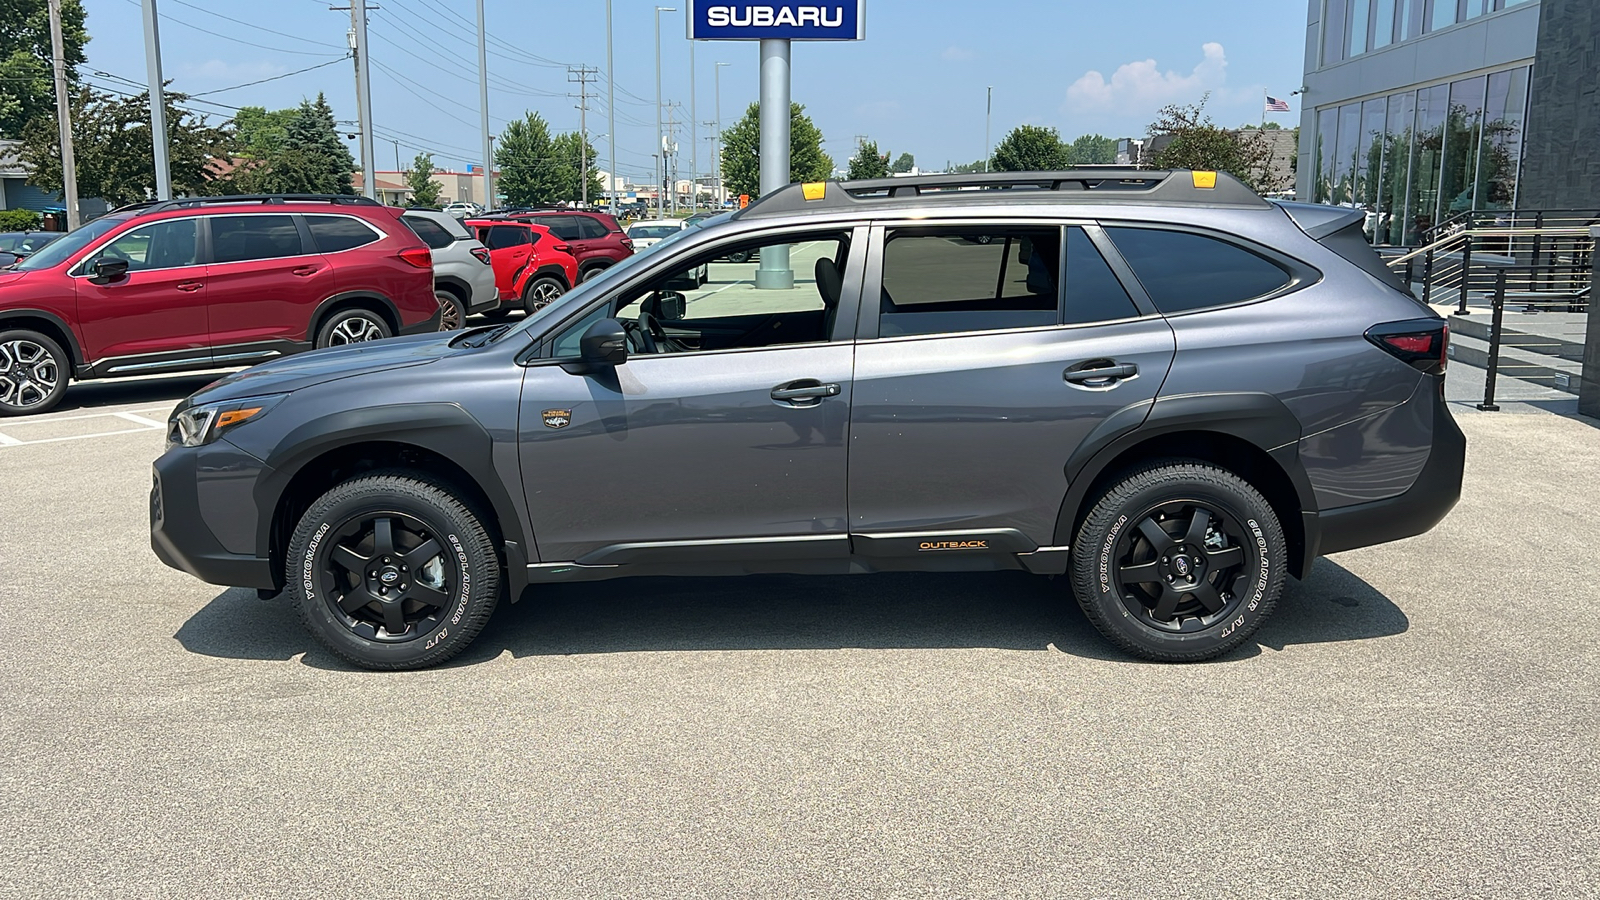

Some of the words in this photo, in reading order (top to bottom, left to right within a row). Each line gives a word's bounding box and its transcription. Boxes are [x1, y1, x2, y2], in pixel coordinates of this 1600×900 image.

[707, 6, 843, 27] SUBARU
[303, 522, 330, 600] YOKOHAMA
[919, 540, 986, 549] OUTBACK
[1100, 515, 1128, 594] YOKOHAMA
[1247, 519, 1269, 612] GEOLANDAR
[449, 534, 471, 625] GEOLANDAR
[425, 627, 448, 650] A/T
[1221, 614, 1245, 638] A/T
